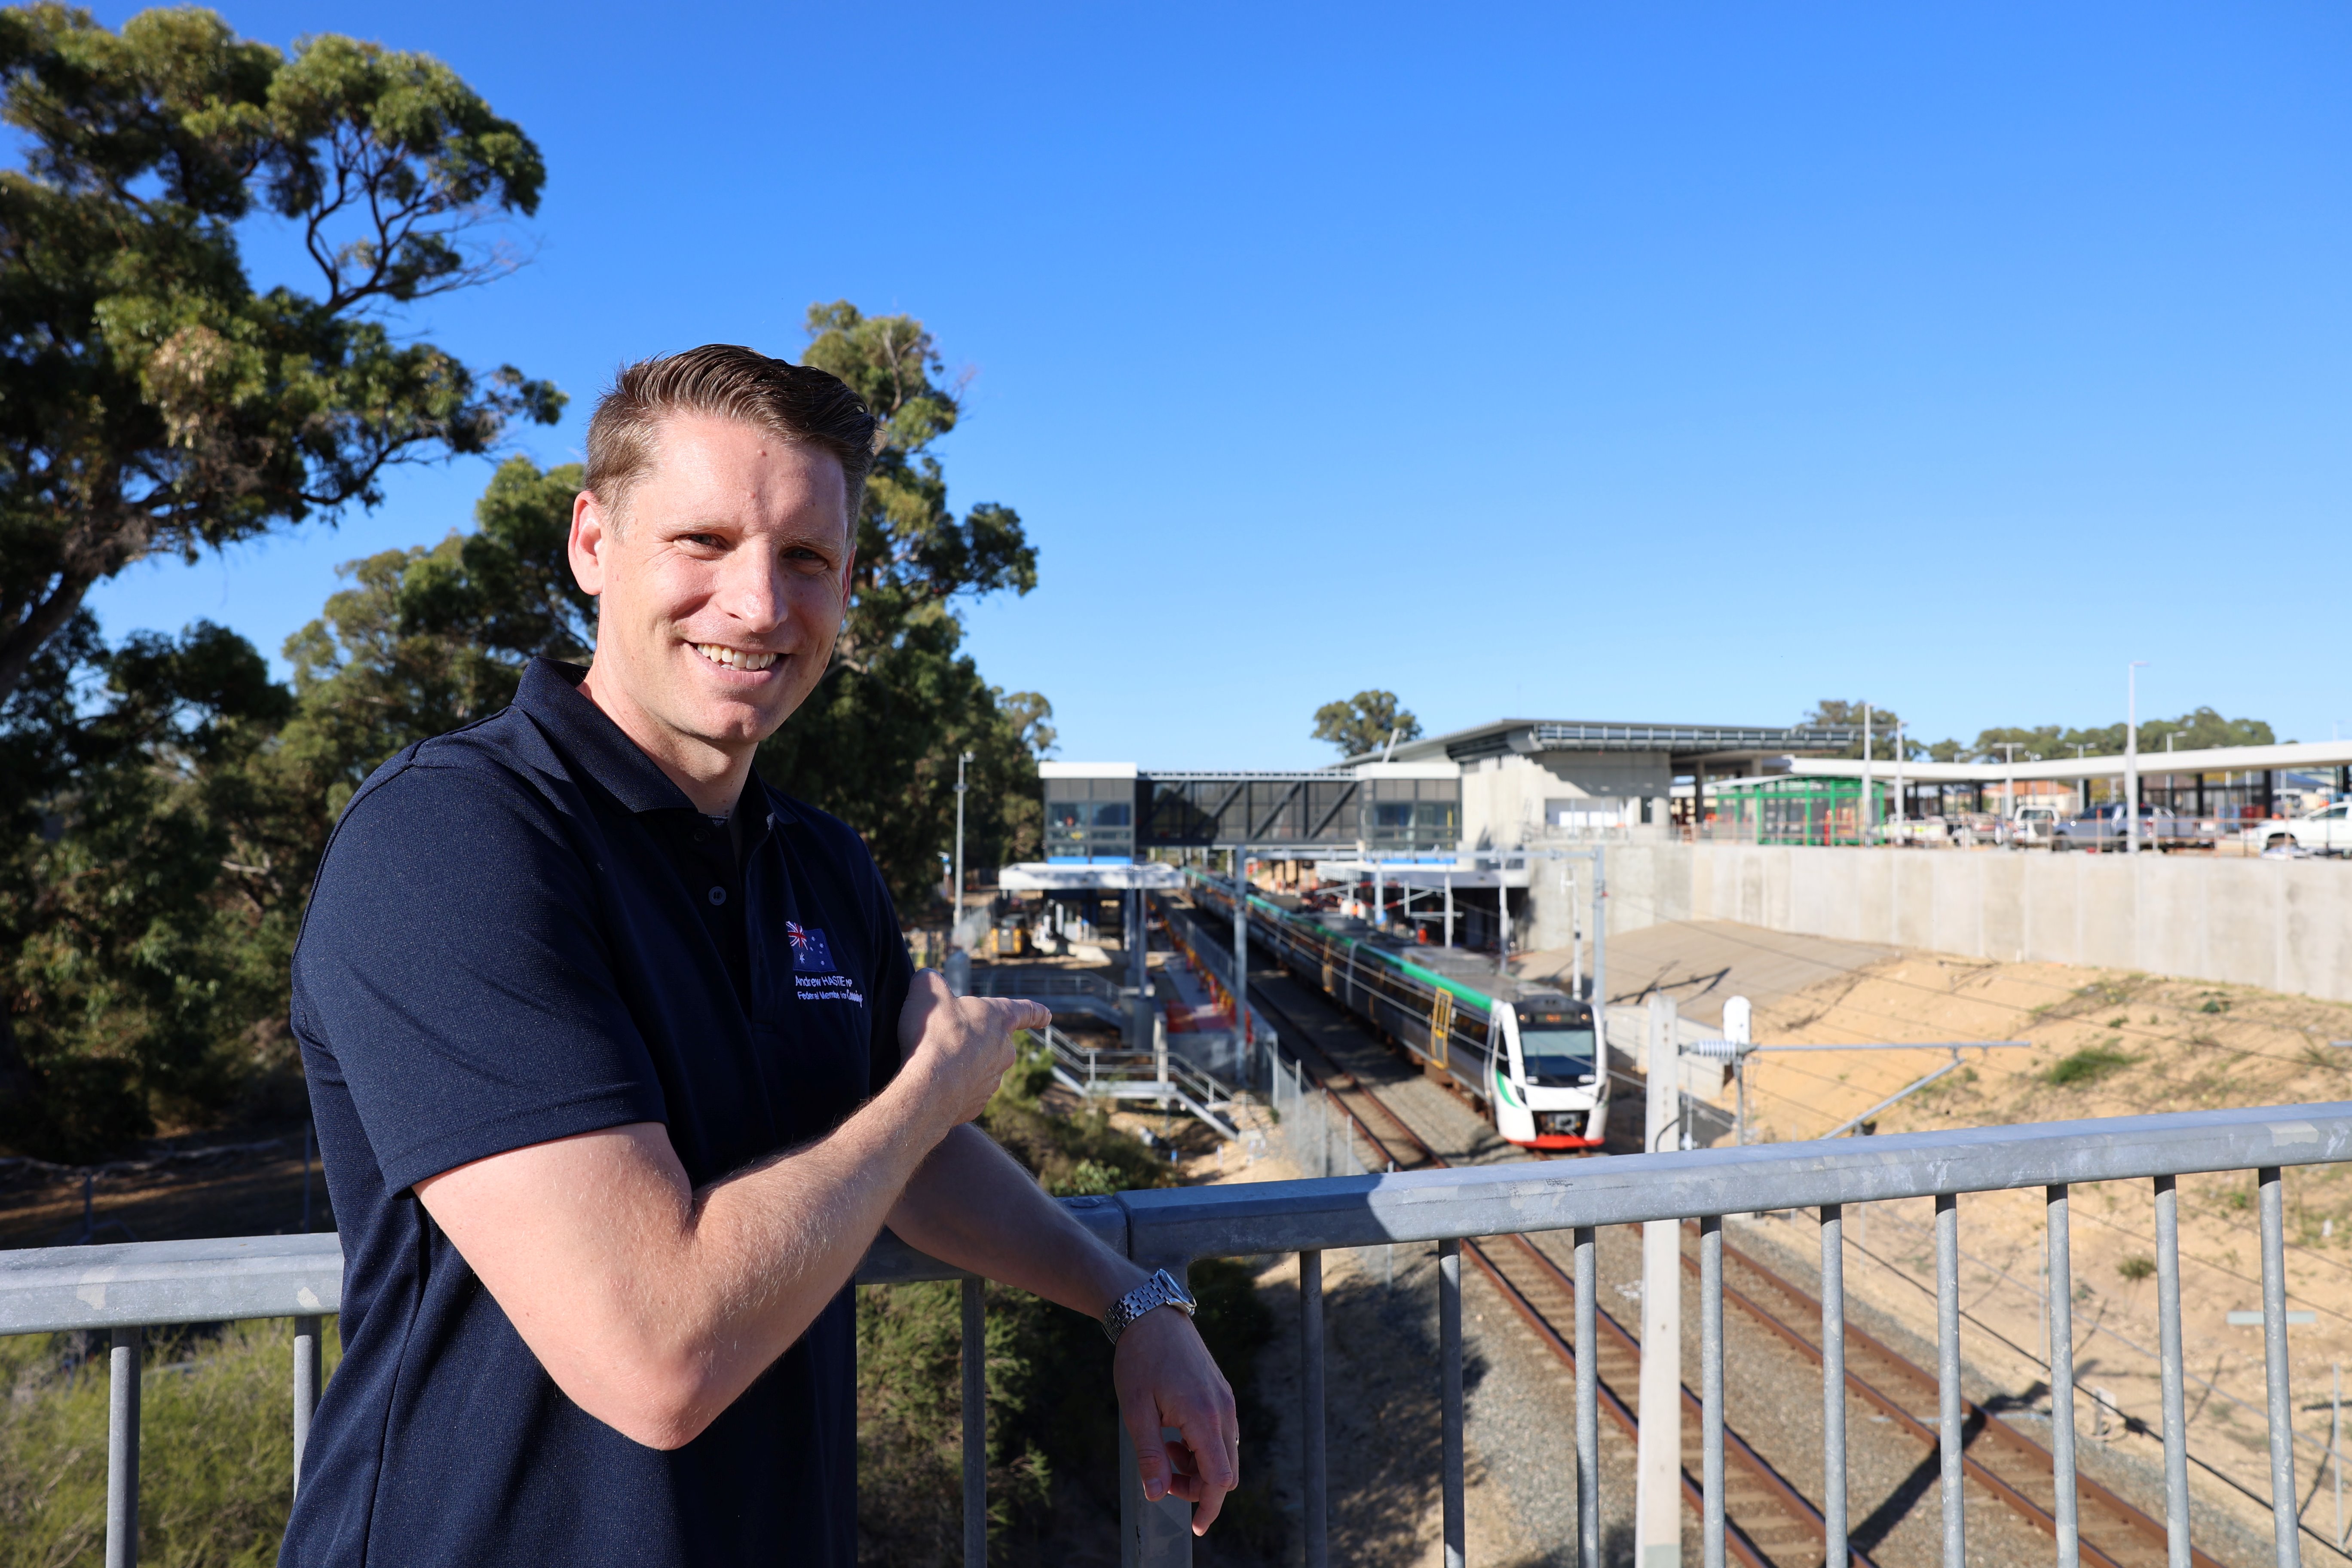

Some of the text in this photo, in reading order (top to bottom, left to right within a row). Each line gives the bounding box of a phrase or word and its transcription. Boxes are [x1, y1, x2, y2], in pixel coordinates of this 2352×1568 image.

[795, 975, 852, 987] Andrew HASTIE MP
[797, 991, 820, 1000] Federal
